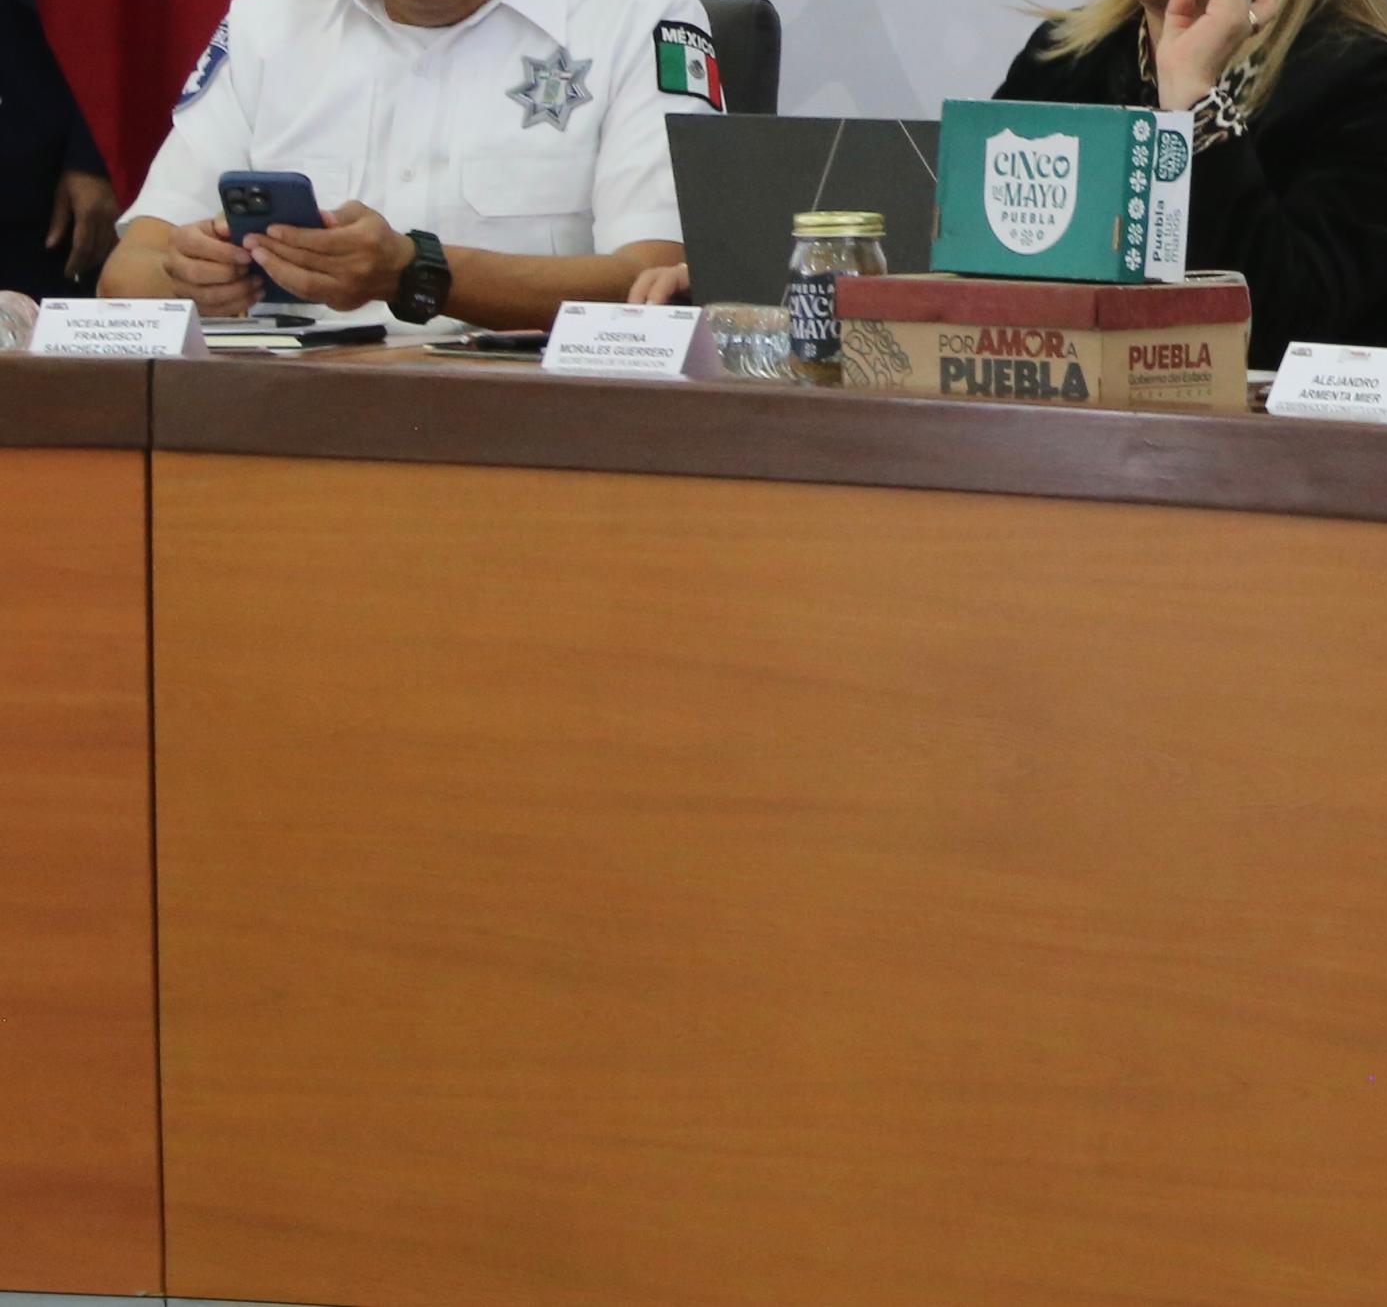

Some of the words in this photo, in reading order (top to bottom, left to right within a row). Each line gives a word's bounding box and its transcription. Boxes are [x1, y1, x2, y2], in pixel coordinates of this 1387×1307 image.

[994, 150, 1070, 180] CINCO
[1004, 182, 1067, 209] MAYO
[1001, 210, 1055, 225] PUEBLA
[939, 334, 976, 354] POR
[976, 327, 1066, 359] AMOR
[1128, 342, 1212, 371] PUEBLA
[940, 356, 1090, 399] PUEBLA
